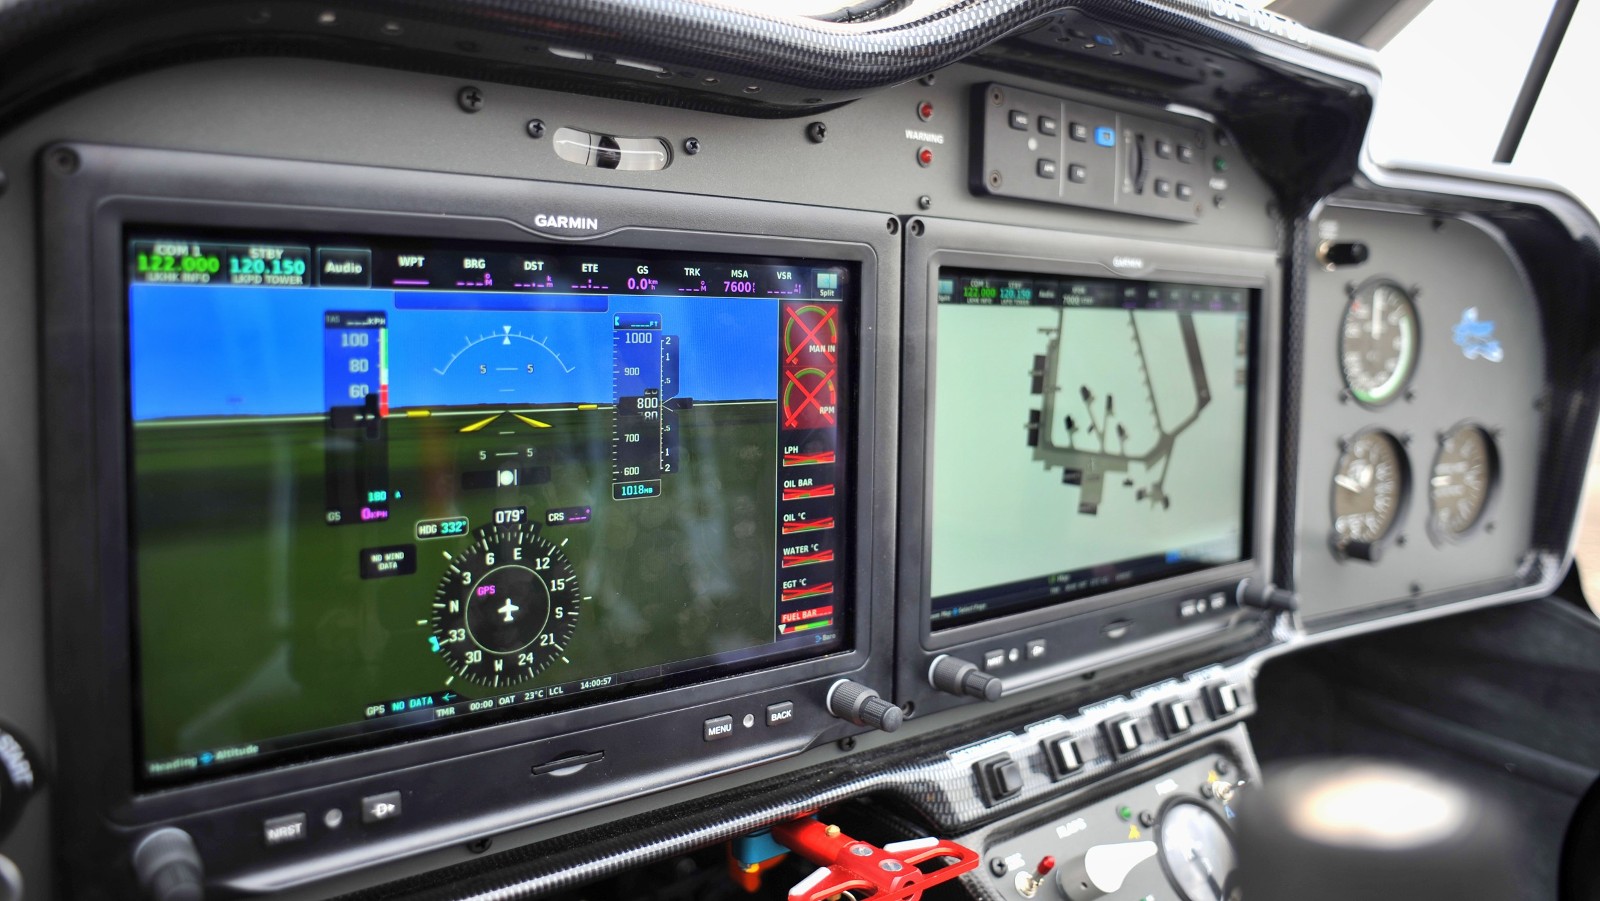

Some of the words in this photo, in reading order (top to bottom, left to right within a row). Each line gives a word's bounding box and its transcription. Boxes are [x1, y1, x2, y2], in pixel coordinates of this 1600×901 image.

[904, 129, 945, 145] WARNING
[534, 213, 599, 231] GARMIN
[153, 243, 188, 257] COM
[192, 245, 202, 257] 1
[249, 246, 285, 259] STBY
[138, 253, 220, 273] 122.000
[230, 257, 306, 275] 120.150
[324, 259, 363, 275] Audio
[397, 255, 425, 268] WPT
[463, 258, 487, 270] BRG
[524, 261, 545, 272] DST
[582, 263, 600, 273] ETE
[636, 265, 649, 276] GS
[684, 267, 702, 278] TRK
[730, 269, 748, 280] MSA
[776, 271, 792, 281] VSR
[181, 273, 211, 284] INFO
[264, 274, 304, 286] TOWER
[722, 280, 751, 293] 7600
[963, 287, 997, 298] 122.000
[819, 288, 835, 299] Split
[341, 333, 370, 347] 100
[624, 331, 653, 345] 1000
[664, 336, 672, 345] 2
[809, 344, 826, 354] MAN
[827, 344, 837, 353] IN
[665, 352, 671, 361] 1
[349, 358, 370, 373] 80
[479, 363, 488, 375] 5
[526, 363, 535, 375] 5
[623, 366, 641, 377] 900
[663, 376, 672, 385] .5
[349, 383, 370, 399] 60
[636, 396, 659, 410] 800
[819, 406, 836, 416] RPM
[663, 424, 671, 433] .5
[623, 433, 641, 443] 700
[479, 449, 488, 461] 5
[526, 447, 535, 458] 5
[664, 447, 671, 457] 1
[783, 445, 800, 455] LPH
[623, 466, 641, 477] 600
[664, 462, 672, 473] 2
[783, 479, 797, 489] OIL
[798, 477, 814, 488] BAR
[326, 510, 342, 523] GS
[547, 511, 566, 523] CRS
[783, 513, 797, 522] OIL
[797, 511, 807, 521] °C
[418, 524, 438, 536] HDG
[513, 546, 523, 561] E
[783, 544, 810, 556] WATER
[810, 543, 820, 552] °C
[371, 552, 383, 563] NO
[384, 550, 405, 562] WIND
[485, 551, 496, 566] 6
[377, 560, 399, 571] DATA
[534, 556, 551, 571] 12
[461, 570, 472, 585] 3
[783, 579, 798, 590] EGT
[798, 577, 808, 586] °C
[476, 584, 497, 597] GPS
[550, 578, 566, 592] 15
[449, 599, 460, 613] N
[554, 606, 564, 619] S
[782, 613, 801, 624] FUEL
[801, 609, 818, 620] BAR
[448, 628, 467, 642] 33
[540, 633, 556, 647] 21
[464, 650, 483, 664] 30
[517, 651, 534, 667] 24
[493, 658, 504, 672] W
[435, 705, 457, 719] TMR
[469, 699, 495, 712] 00:00
[498, 694, 517, 706] OAT
[524, 689, 546, 702] 23°C
[549, 685, 565, 698] LCL
[580, 676, 613, 690] 14:00:57
[366, 704, 386, 717] GPS
[391, 700, 406, 713] NO
[409, 695, 434, 709] DATA
[707, 723, 733, 737] MENU
[771, 708, 793, 723] BACK
[148, 756, 199, 774] Heading
[215, 743, 261, 761] Altitude
[266, 821, 304, 842] NRST
